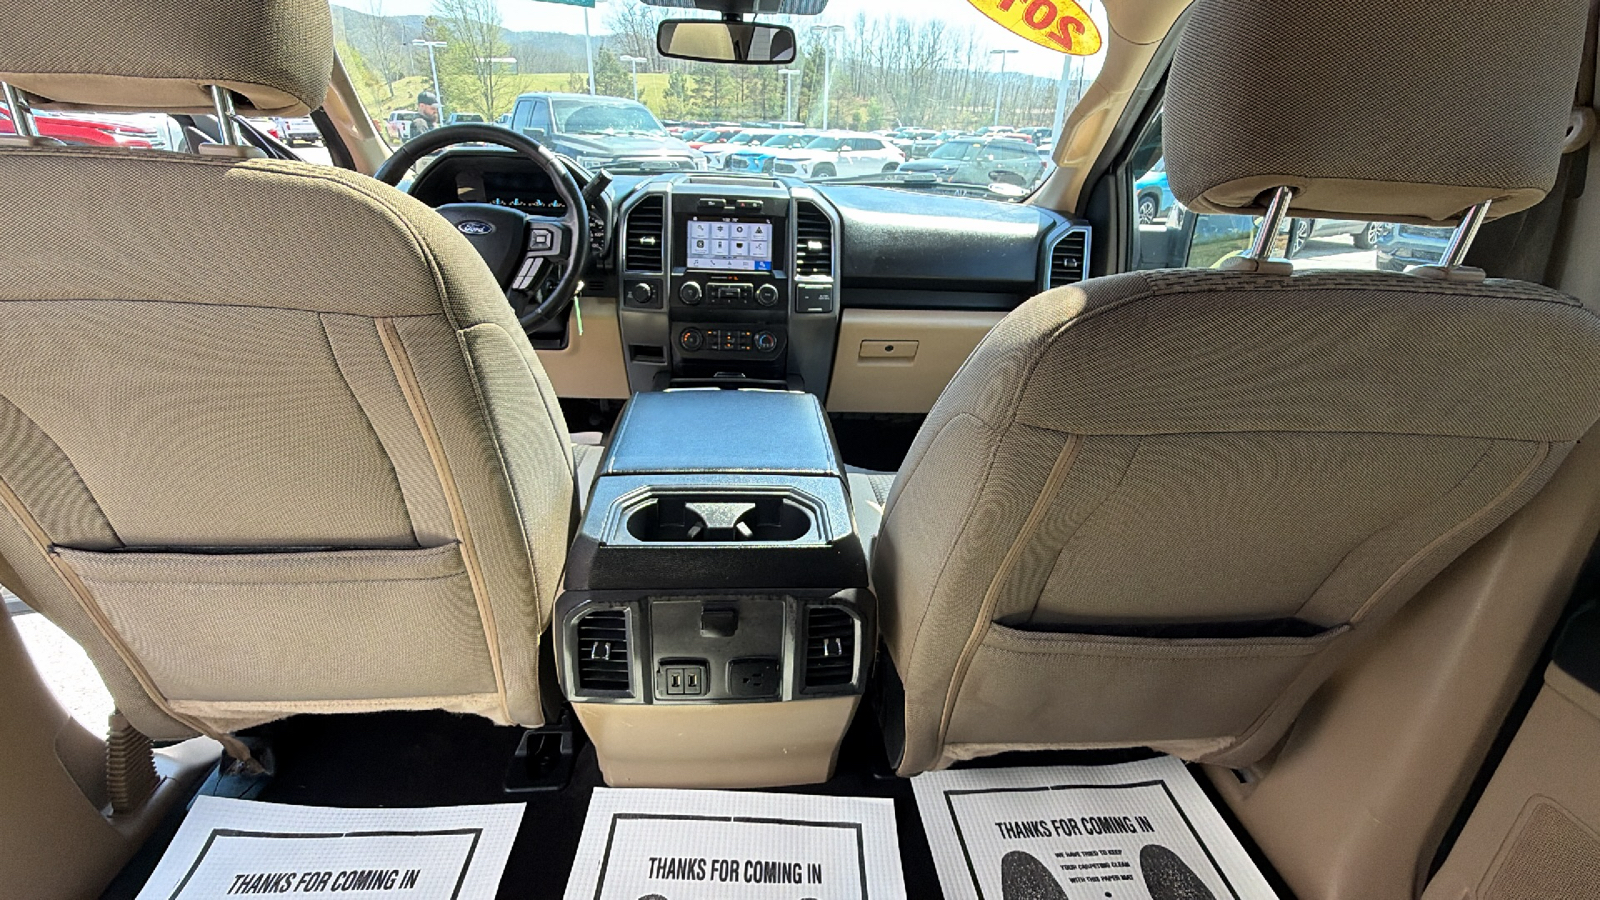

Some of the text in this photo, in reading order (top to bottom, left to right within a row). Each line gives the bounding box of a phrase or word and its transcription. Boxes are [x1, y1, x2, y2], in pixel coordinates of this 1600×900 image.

[464, 222, 485, 233] Ford
[995, 815, 1155, 840] THANKS FOR COMING IN
[1081, 850, 1099, 858] TRIED
[648, 857, 823, 884] THANKS FOR COMING IN
[226, 868, 421, 896] THANKS FOR COMING IN
[1069, 876, 1086, 884] WITH
